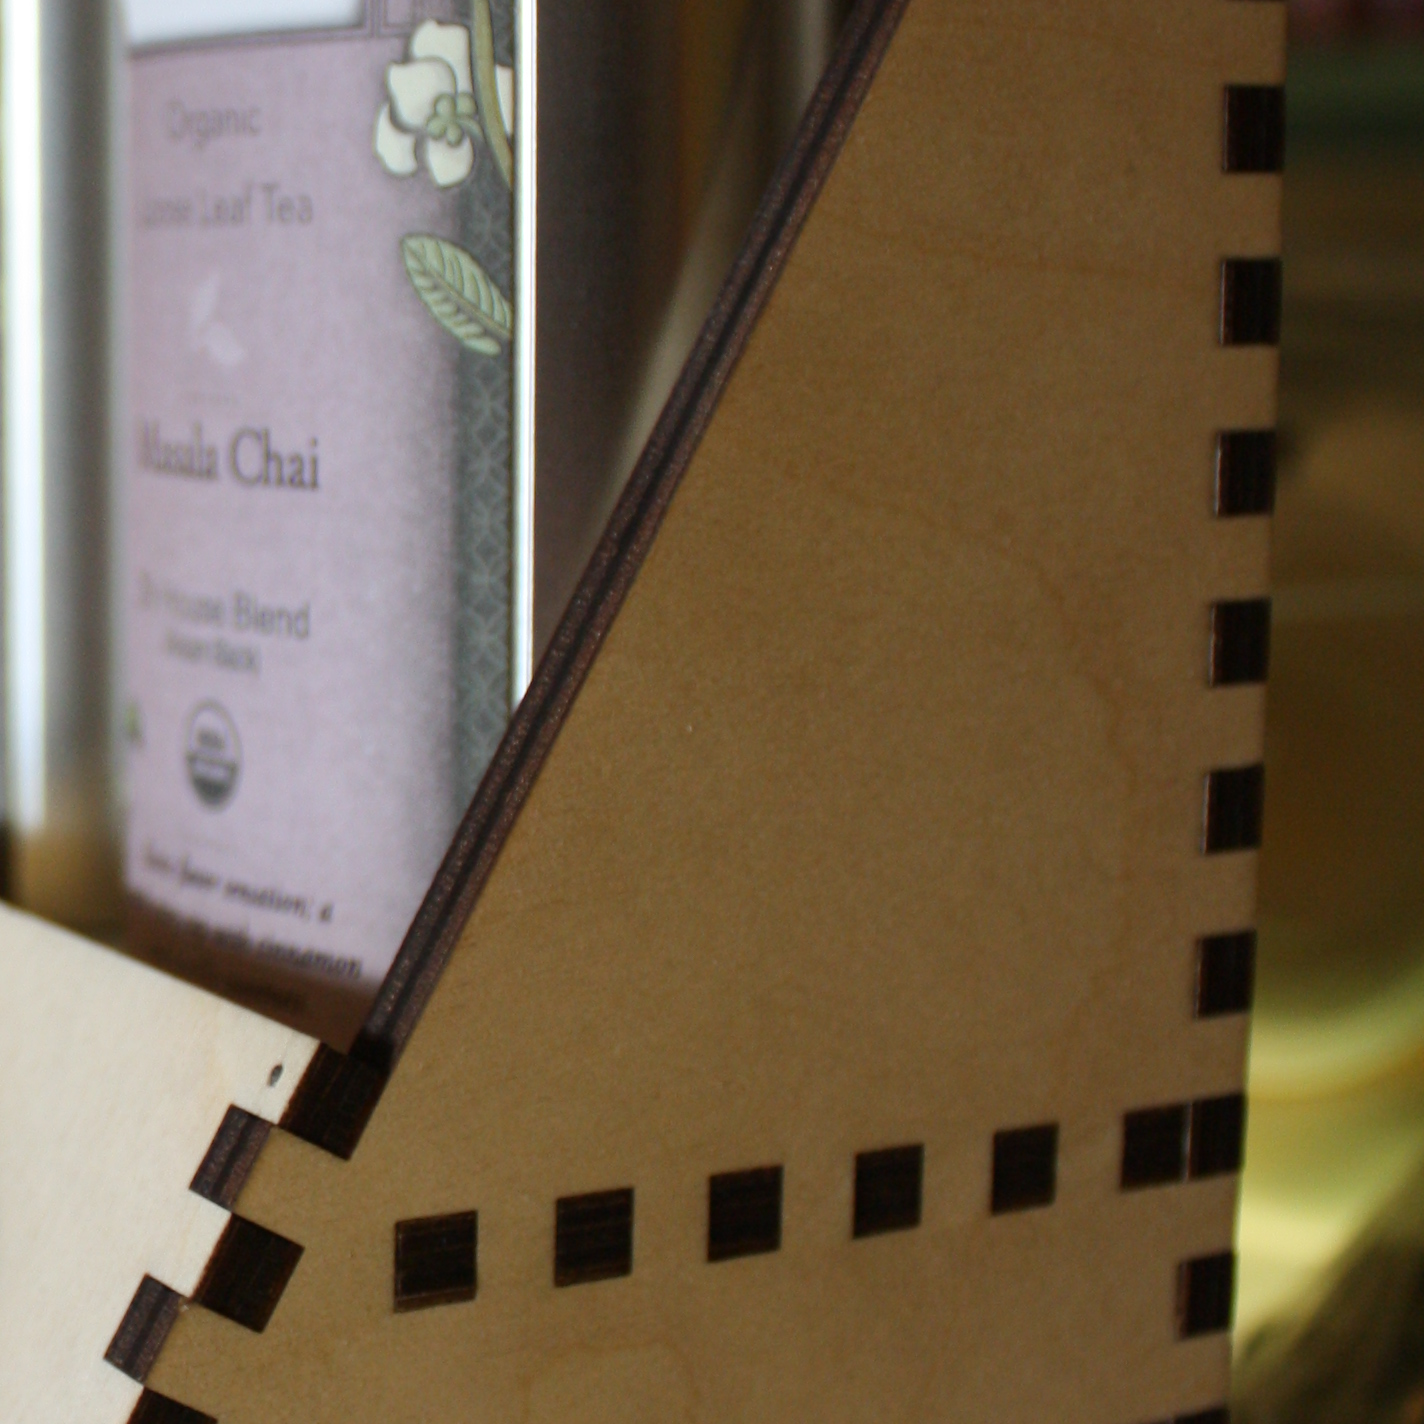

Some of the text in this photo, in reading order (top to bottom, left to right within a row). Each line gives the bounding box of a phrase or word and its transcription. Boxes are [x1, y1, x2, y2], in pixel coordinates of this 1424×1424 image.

[164, 98, 263, 150] Organic
[260, 180, 313, 225] Tea
[228, 426, 320, 490] Chai
[233, 590, 310, 641] Blend
